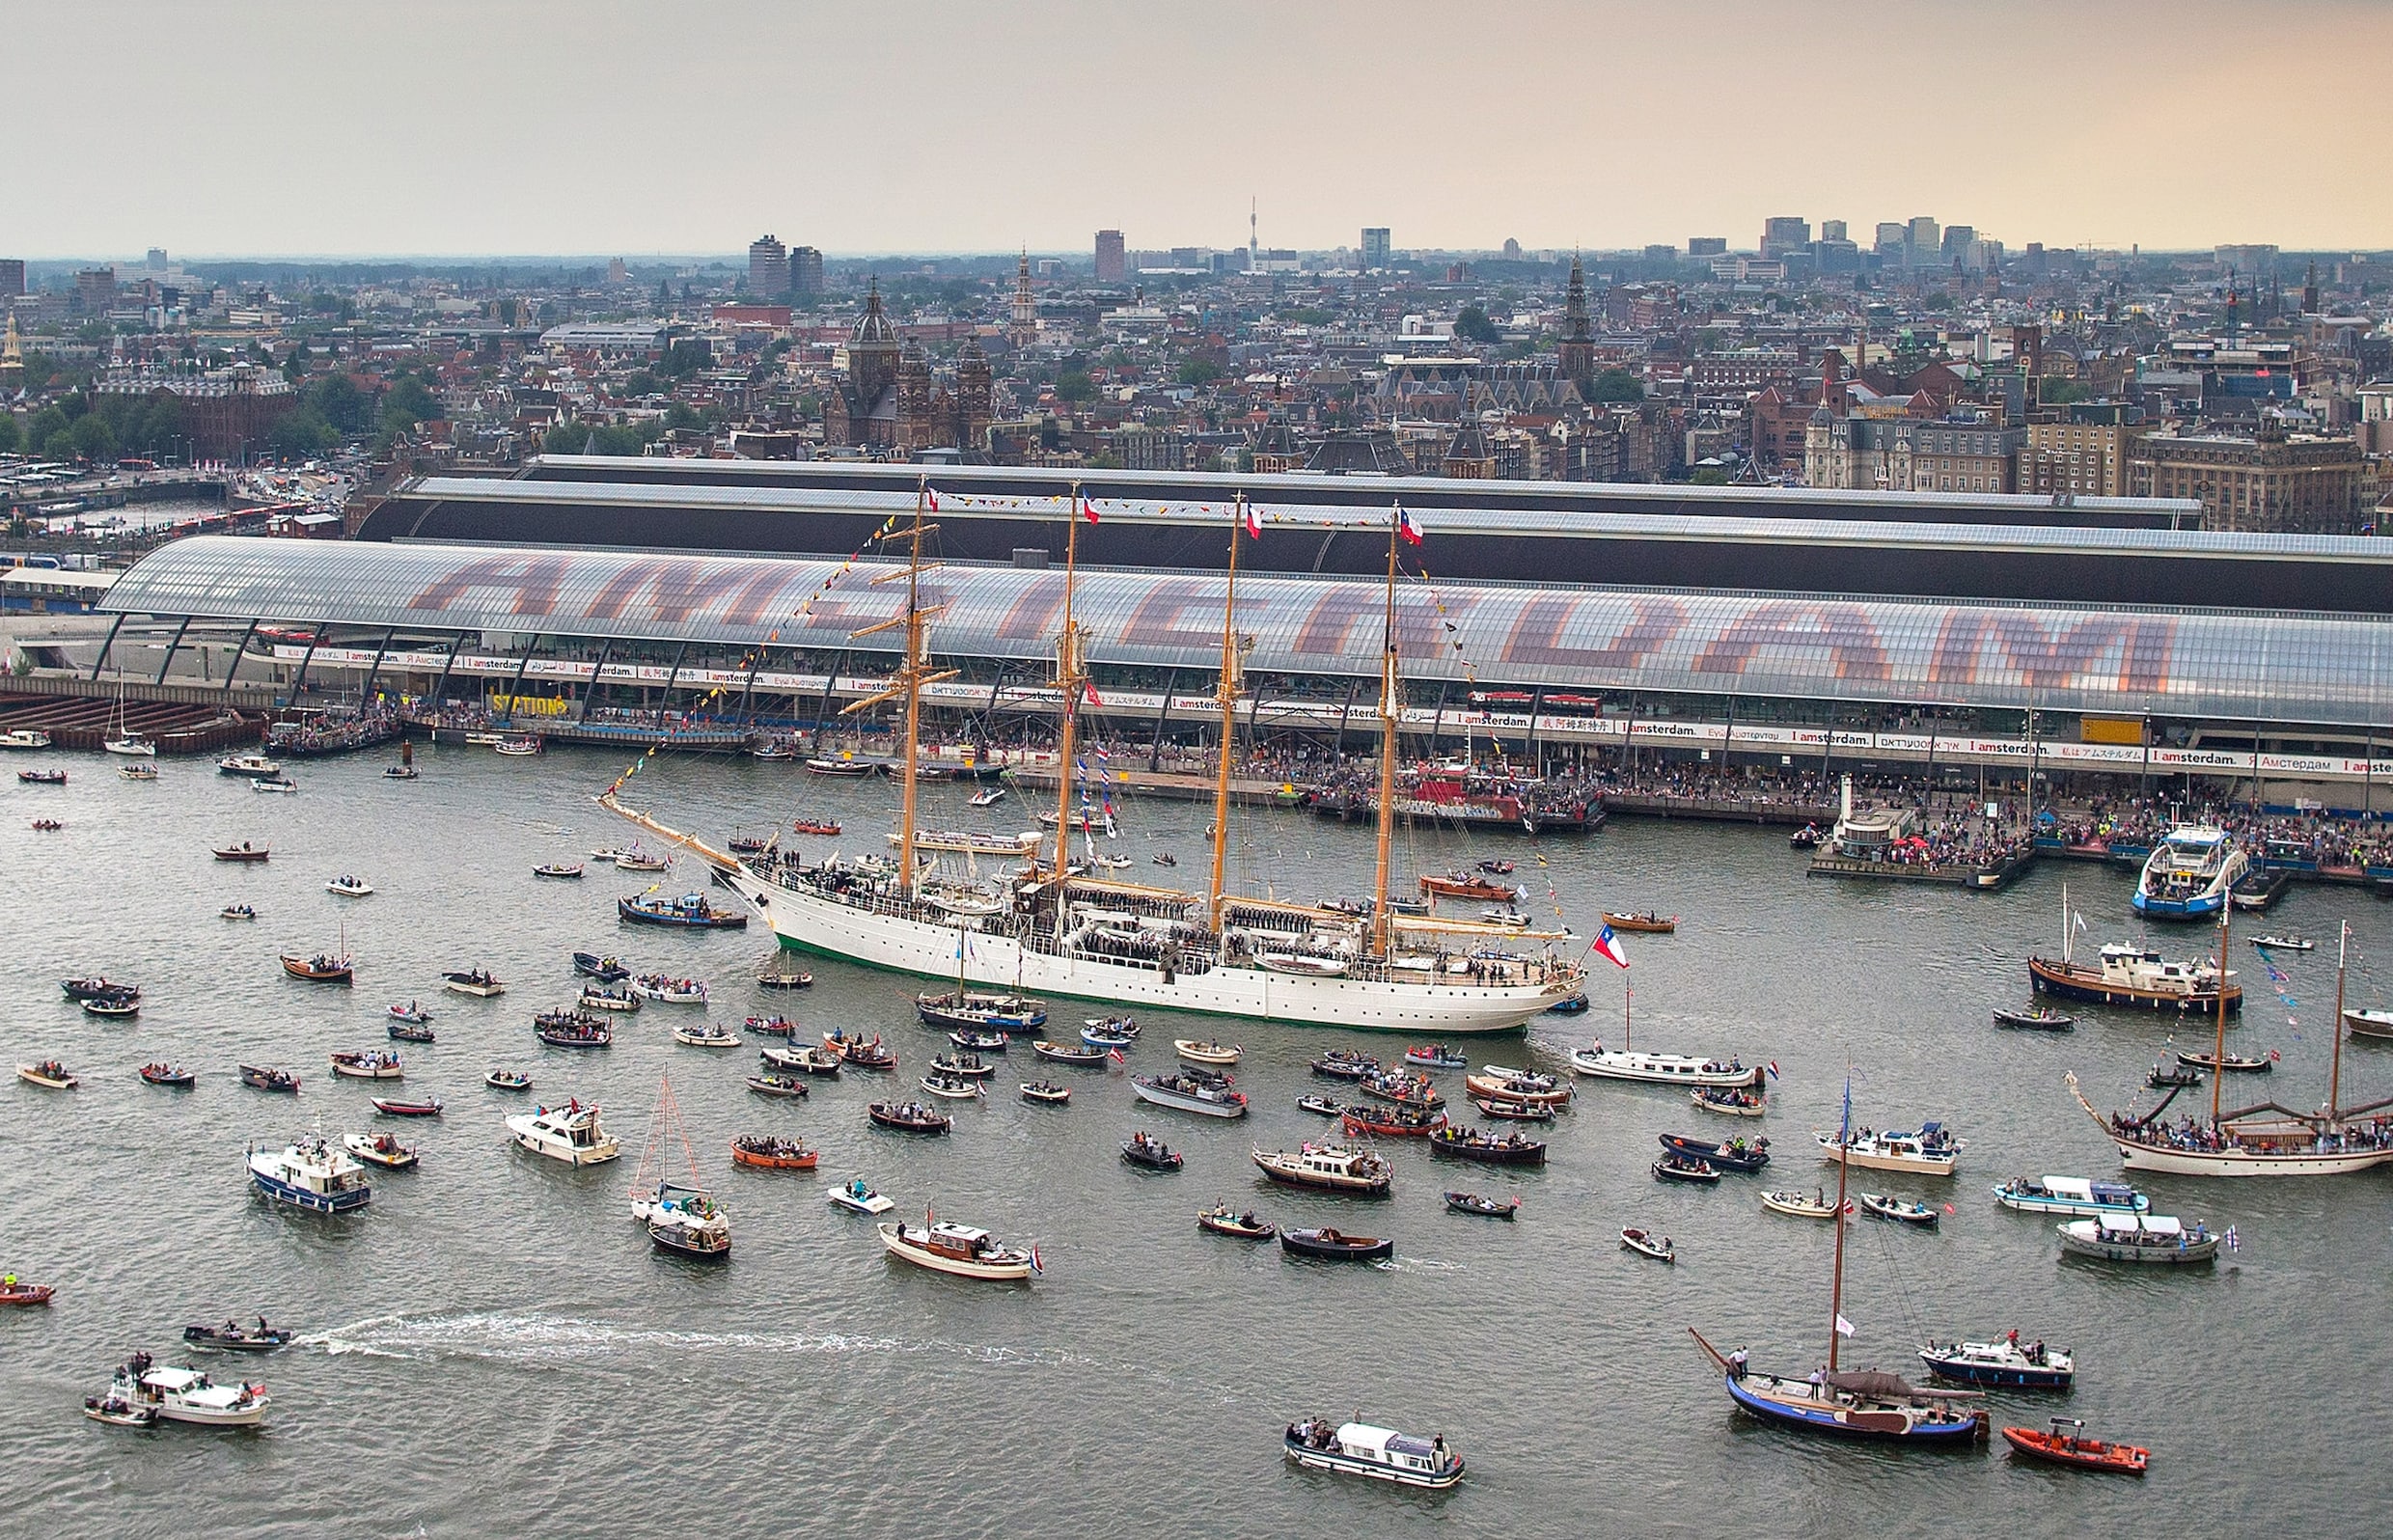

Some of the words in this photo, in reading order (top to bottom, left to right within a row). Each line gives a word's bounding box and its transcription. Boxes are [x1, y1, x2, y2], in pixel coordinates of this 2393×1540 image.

[406, 551, 2178, 693] AMSTERDAM
[415, 656, 459, 666] Амстерм
[2154, 751, 2158, 760] I
[2161, 753, 2237, 765] amsterdam.
[2261, 756, 2330, 770] Амстердам
[2344, 760, 2348, 771] I
